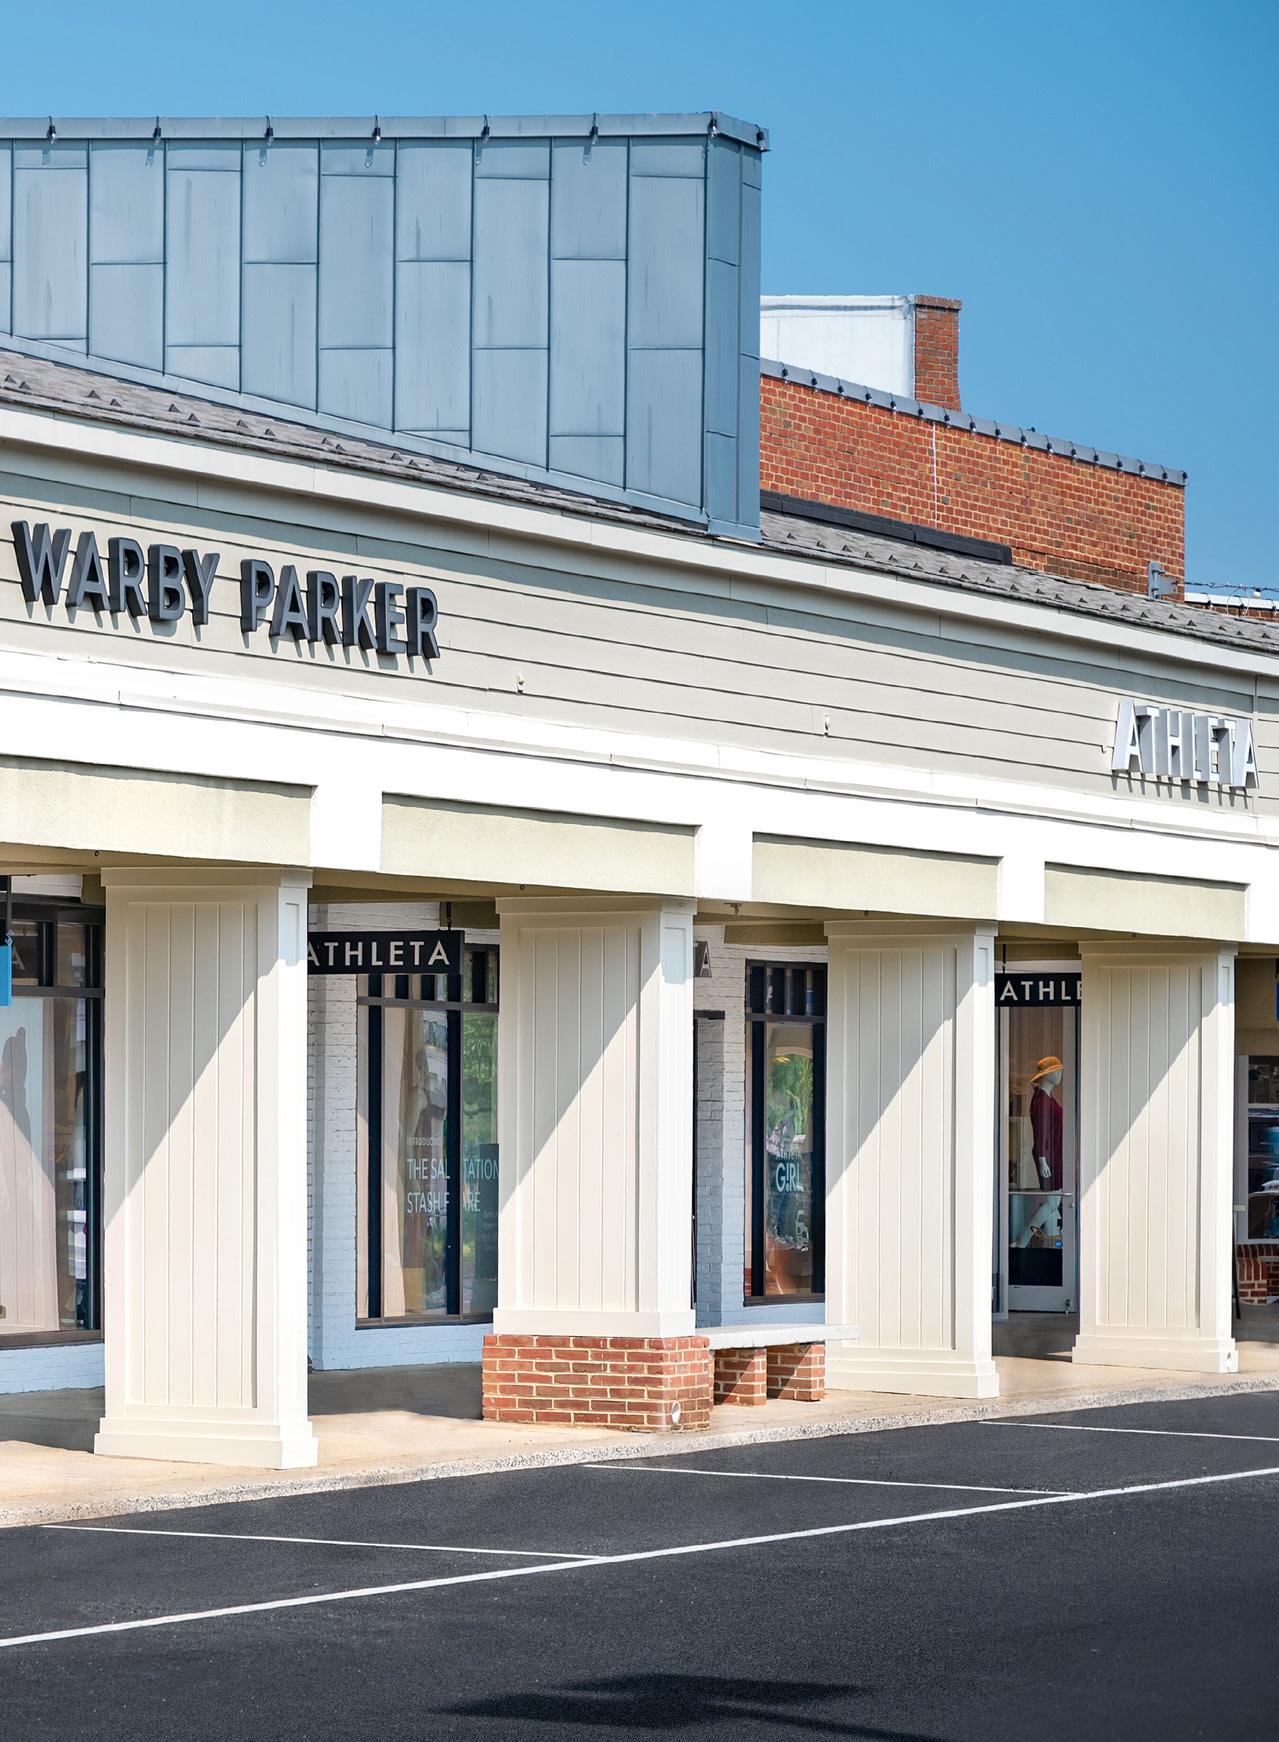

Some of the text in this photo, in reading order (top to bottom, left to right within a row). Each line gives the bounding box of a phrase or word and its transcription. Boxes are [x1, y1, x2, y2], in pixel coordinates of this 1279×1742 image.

[11, 520, 441, 658] WARBY PARKER
[1111, 699, 1260, 789] ATHLETA
[406, 1158, 499, 1180] THE SALTATION
[407, 1191, 440, 1214] STASH
